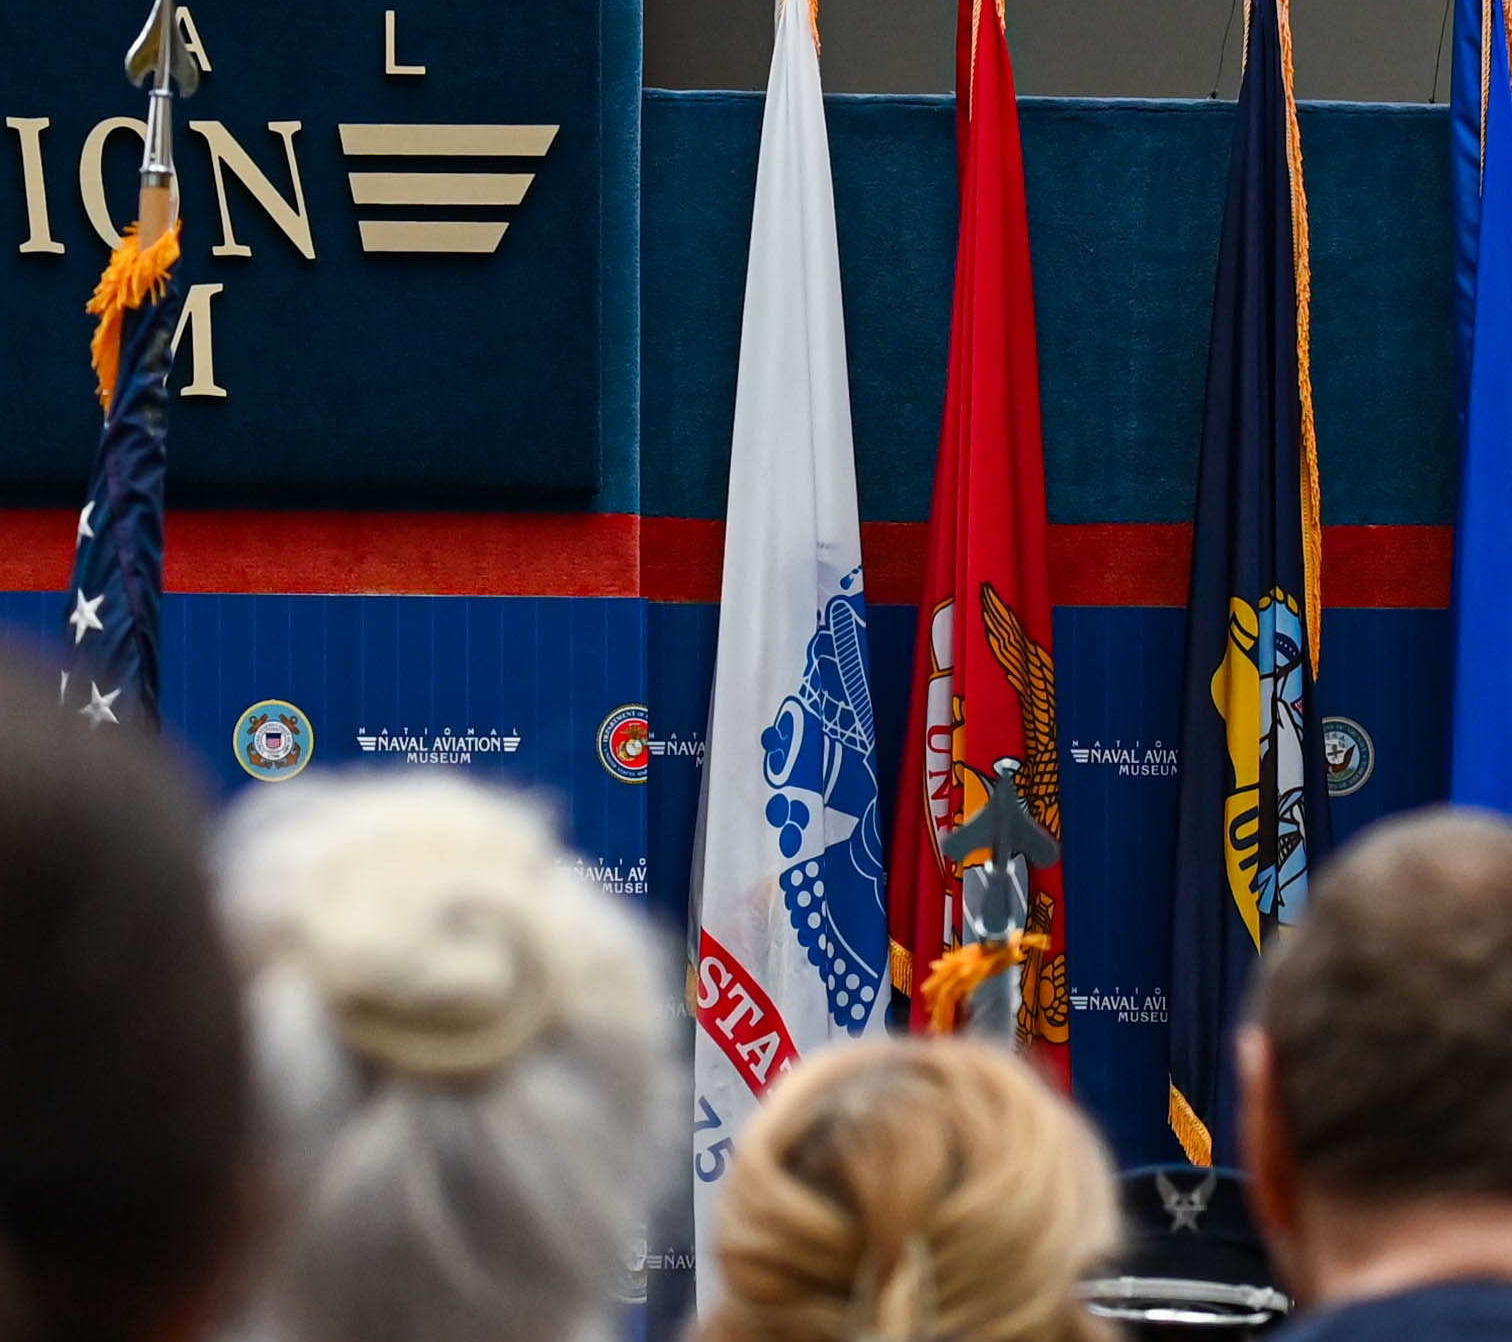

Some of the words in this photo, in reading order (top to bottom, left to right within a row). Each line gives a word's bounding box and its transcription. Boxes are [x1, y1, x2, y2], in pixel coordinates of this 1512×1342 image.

[378, 737, 428, 752] NAVAL
[432, 737, 501, 752] AVIATION
[667, 741, 705, 756] NAVA
[1072, 740, 1162, 748] NATIO
[406, 752, 472, 764] MUSEUM
[1091, 749, 1140, 764] NAVAL
[1071, 986, 1162, 995] NATIO
[1089, 996, 1139, 1011] NAVAL
[1118, 1011, 1168, 1023] MUSEU
